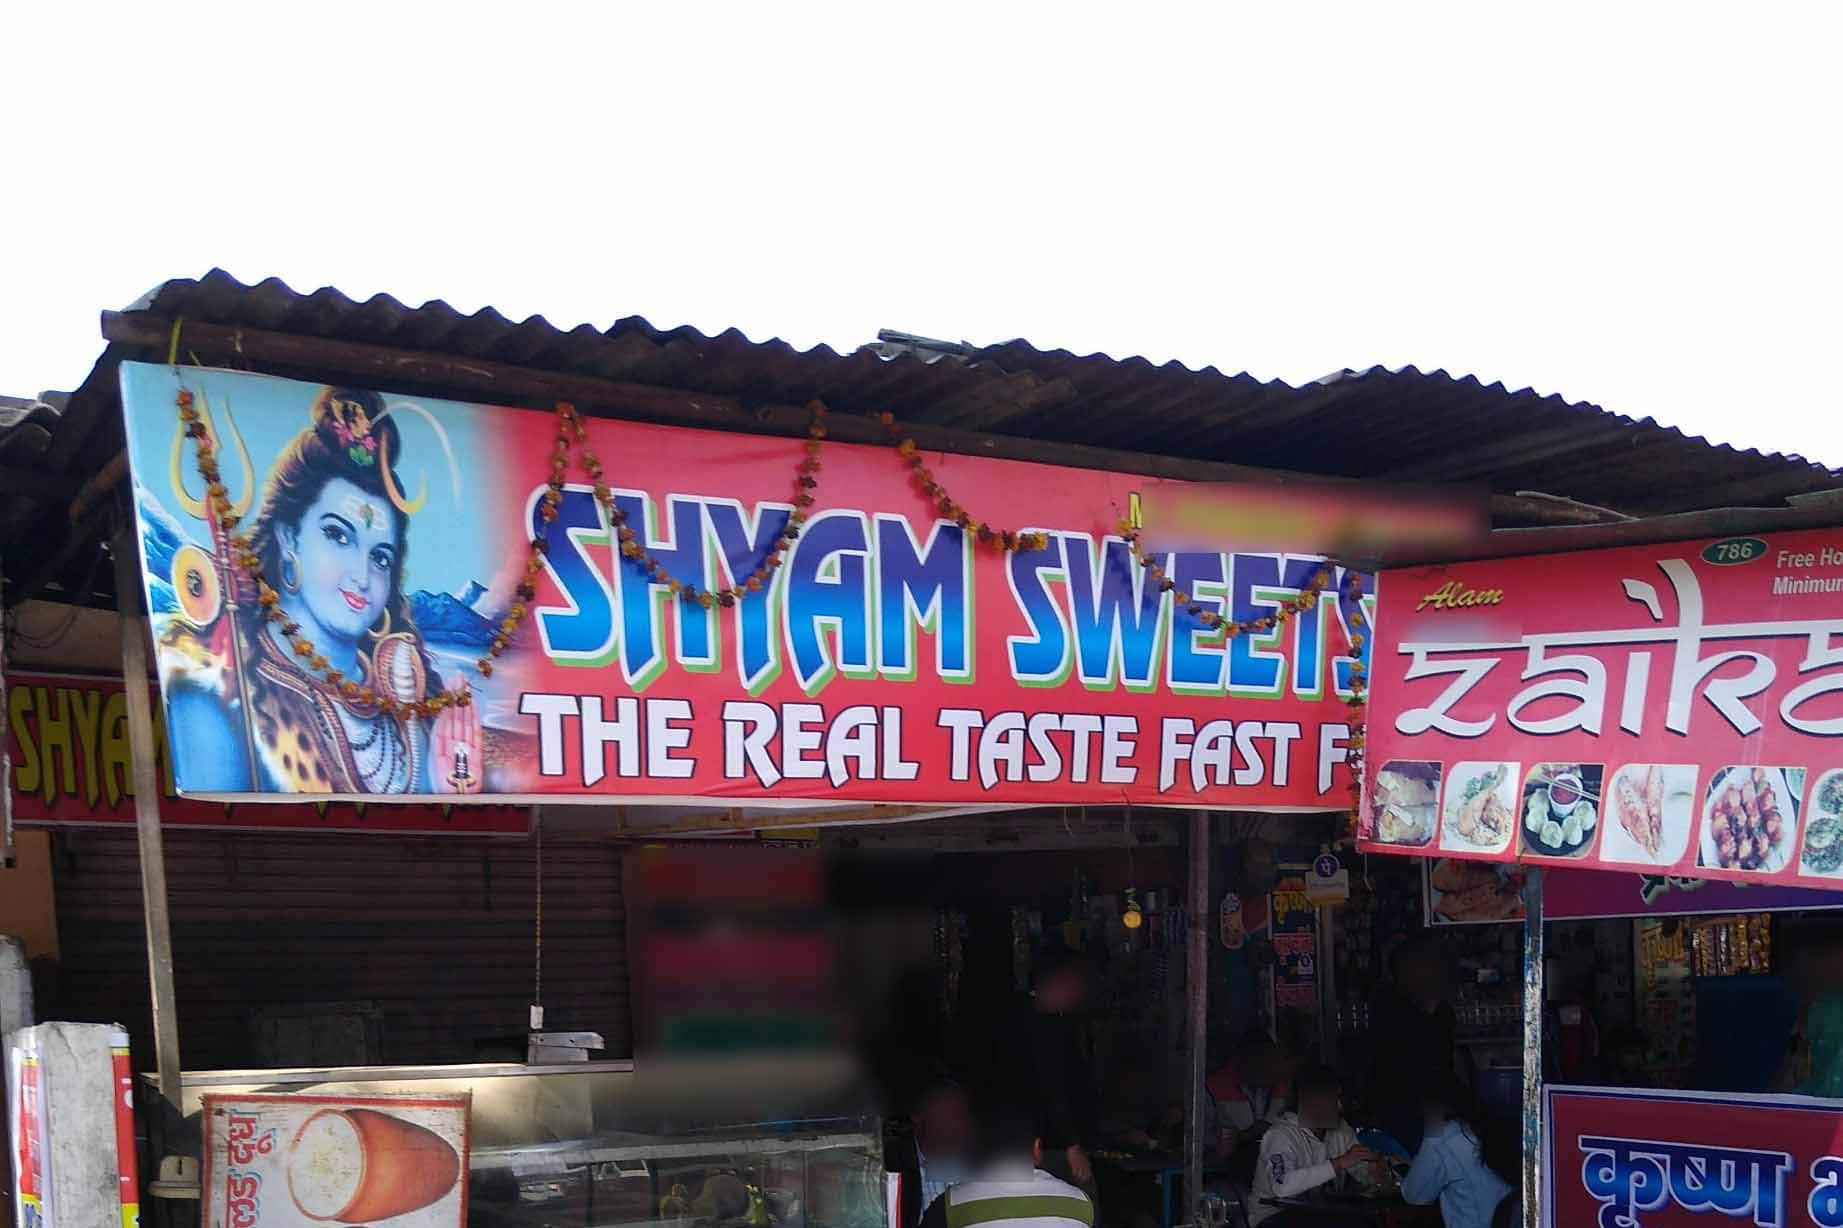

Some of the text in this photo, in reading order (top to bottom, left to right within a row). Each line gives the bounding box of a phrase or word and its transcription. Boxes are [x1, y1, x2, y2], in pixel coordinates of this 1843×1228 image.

[1716, 541, 1753, 562] 786
[1776, 549, 1815, 569] Free
[525, 483, 975, 696] SHYAM
[1416, 581, 1503, 611] Alam
[519, 692, 694, 787] THE
[722, 701, 920, 790] REAL
[937, 707, 1139, 791] TASTE
[1158, 716, 1302, 793] FAST
